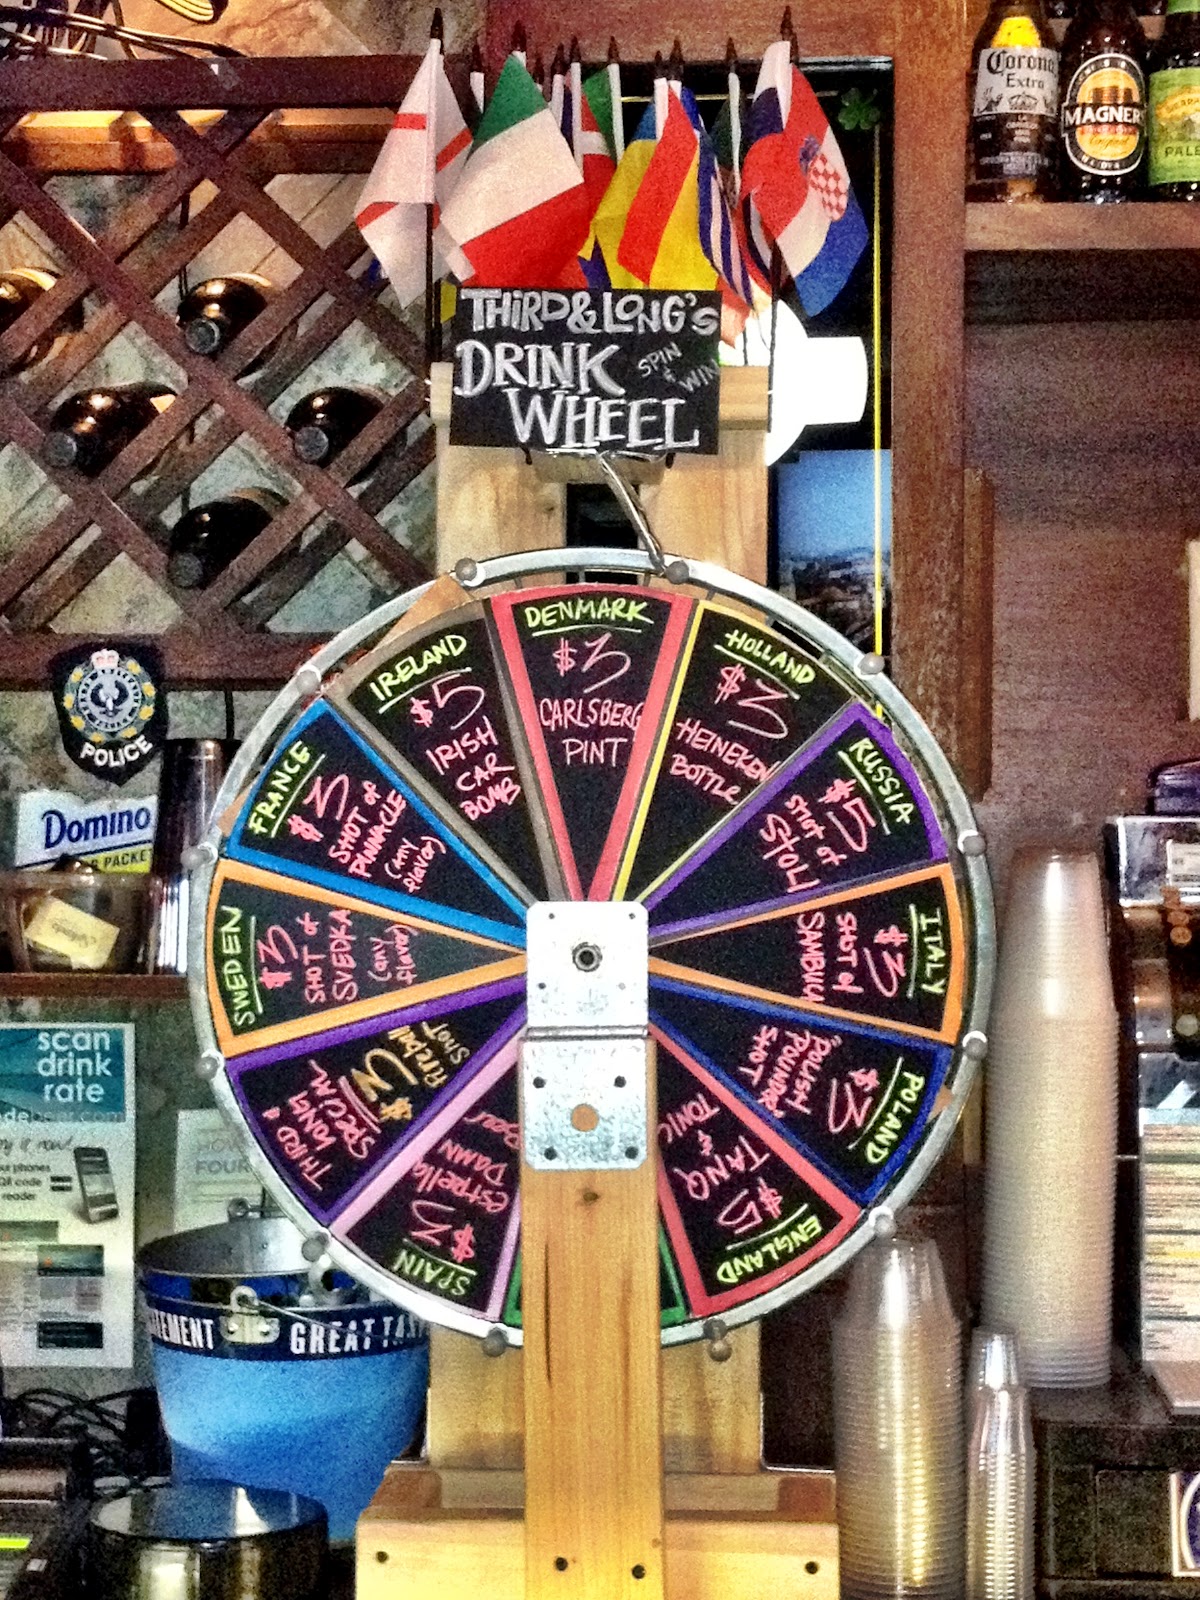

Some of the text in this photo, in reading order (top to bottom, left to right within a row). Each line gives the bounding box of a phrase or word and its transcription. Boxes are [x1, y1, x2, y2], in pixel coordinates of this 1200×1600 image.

[1006, 72, 1044, 89] Extra
[453, 338, 627, 399] DRINK
[638, 341, 683, 378] SPIN
[678, 357, 720, 394] WIN
[501, 387, 700, 451] WHEEL
[525, 597, 655, 628] DENMARK
[370, 634, 467, 702] IRELAND
[552, 632, 632, 693] $3
[725, 629, 816, 684] HOLLAND
[410, 673, 485, 730] $5
[539, 698, 646, 733] CARLSBERG
[714, 662, 788, 740] $3
[80, 734, 154, 768] POLICE
[426, 715, 498, 776] IRISH
[456, 752, 515, 792] CAR
[562, 738, 629, 767] PINT
[248, 740, 311, 835] FRANCE
[287, 773, 350, 843] $3
[460, 777, 521, 821] BOMB
[849, 737, 915, 825] RUSSIA
[41, 806, 151, 850] Domino
[328, 780, 382, 864] SHOT of
[348, 788, 407, 879] PINNACLE
[818, 778, 877, 853] $5
[219, 904, 256, 1027] SWEDEN
[256, 925, 299, 990] $3
[329, 908, 359, 1001] SVEDKA
[797, 911, 827, 1003] SAMBUCA
[836, 911, 858, 968] SHOT
[862, 924, 909, 998] $3
[919, 906, 947, 994] ITALY
[303, 943, 327, 1005] SHOT
[37, 1030, 111, 1052] scan
[37, 1051, 112, 1077] drink
[738, 1025, 778, 1087] SHOT
[43, 1079, 105, 1103] rate
[351, 1047, 419, 1122] $3
[827, 1067, 881, 1134] $3
[288, 1090, 337, 1151] LONG
[658, 1092, 721, 1144] TONIC
[864, 1071, 926, 1164] POLAND
[277, 1126, 333, 1192] THIRD
[672, 1134, 771, 1201] TANQ
[717, 1176, 783, 1235] $5
[393, 1249, 471, 1296] SPAIN
[716, 1214, 823, 1284] ENGLAND
[289, 1317, 376, 1355] GREAT
